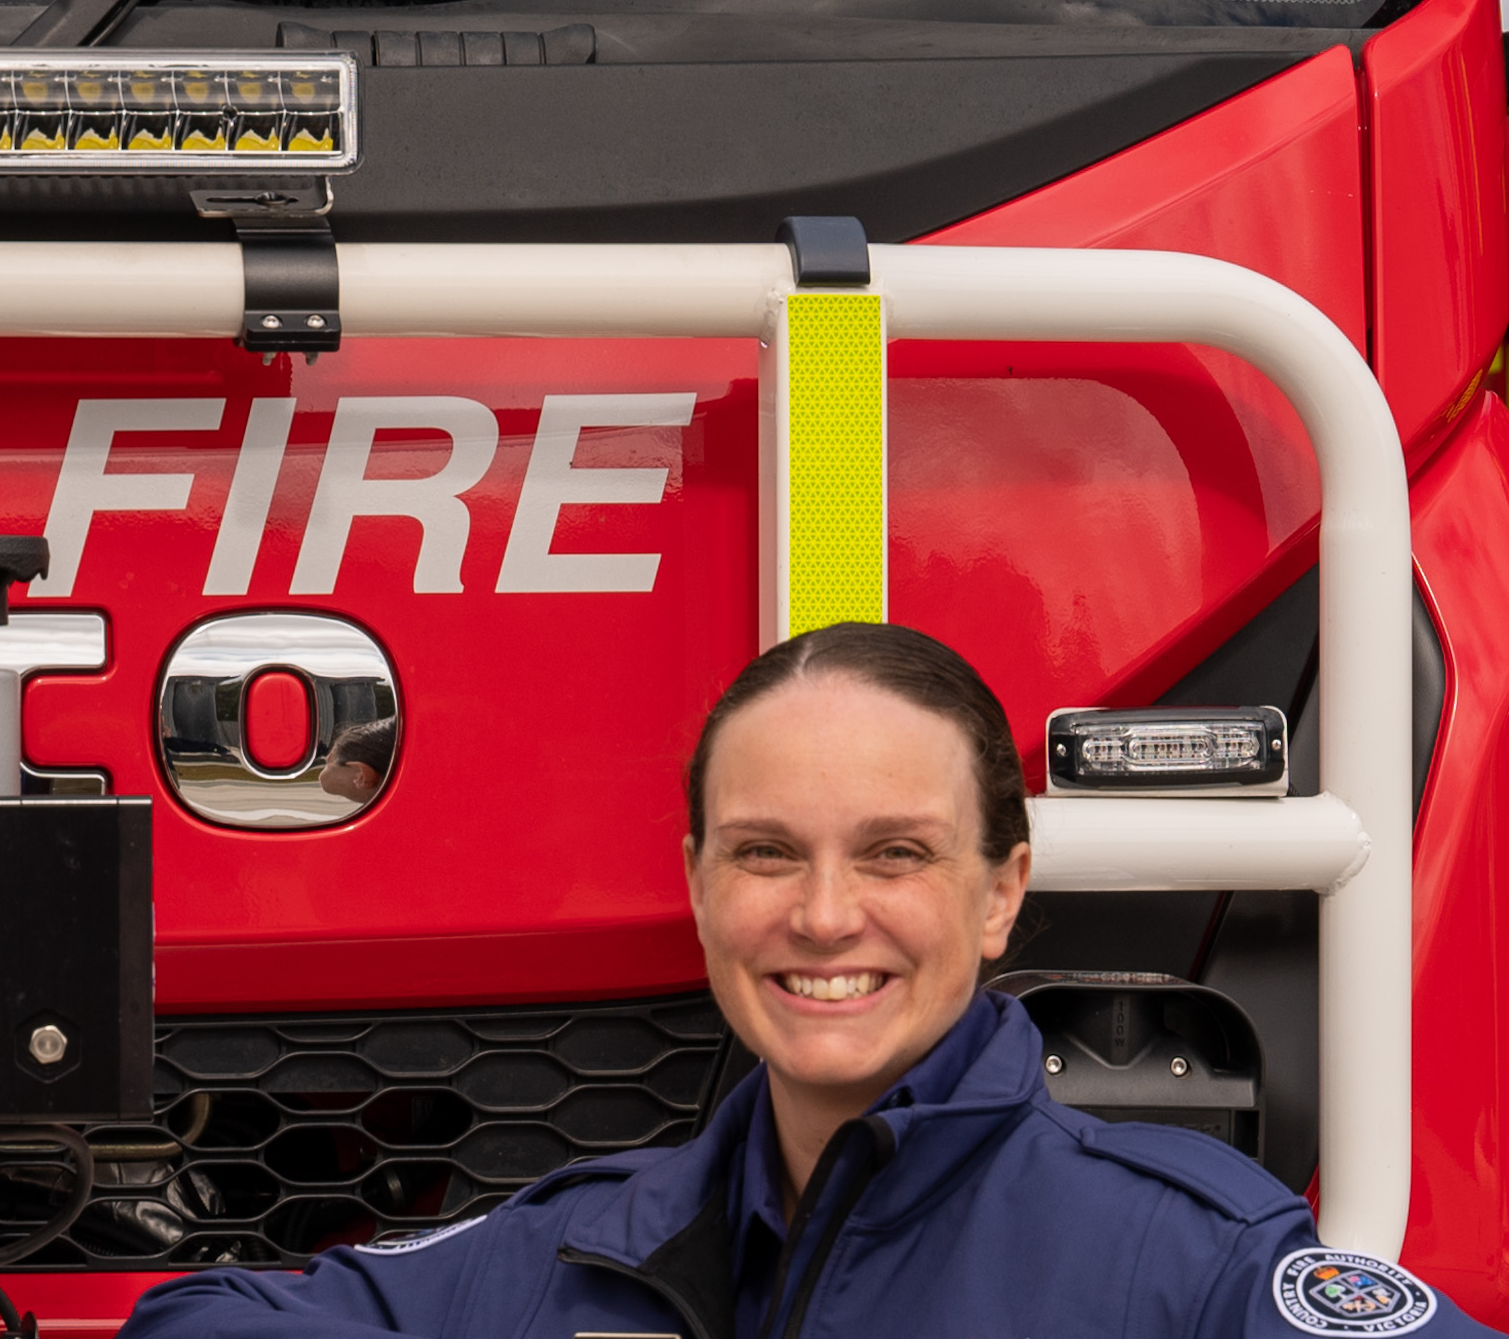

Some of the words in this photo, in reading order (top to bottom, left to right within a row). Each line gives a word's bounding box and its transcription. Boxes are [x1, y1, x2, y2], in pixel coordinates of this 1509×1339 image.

[27, 392, 697, 597] FIRE
[1287, 1255, 1317, 1277] FIRE
[1325, 1253, 1414, 1286] AUTHORITY
[1282, 1281, 1328, 1329] COUNTRY
[1363, 1301, 1428, 1332] VICTORIA
